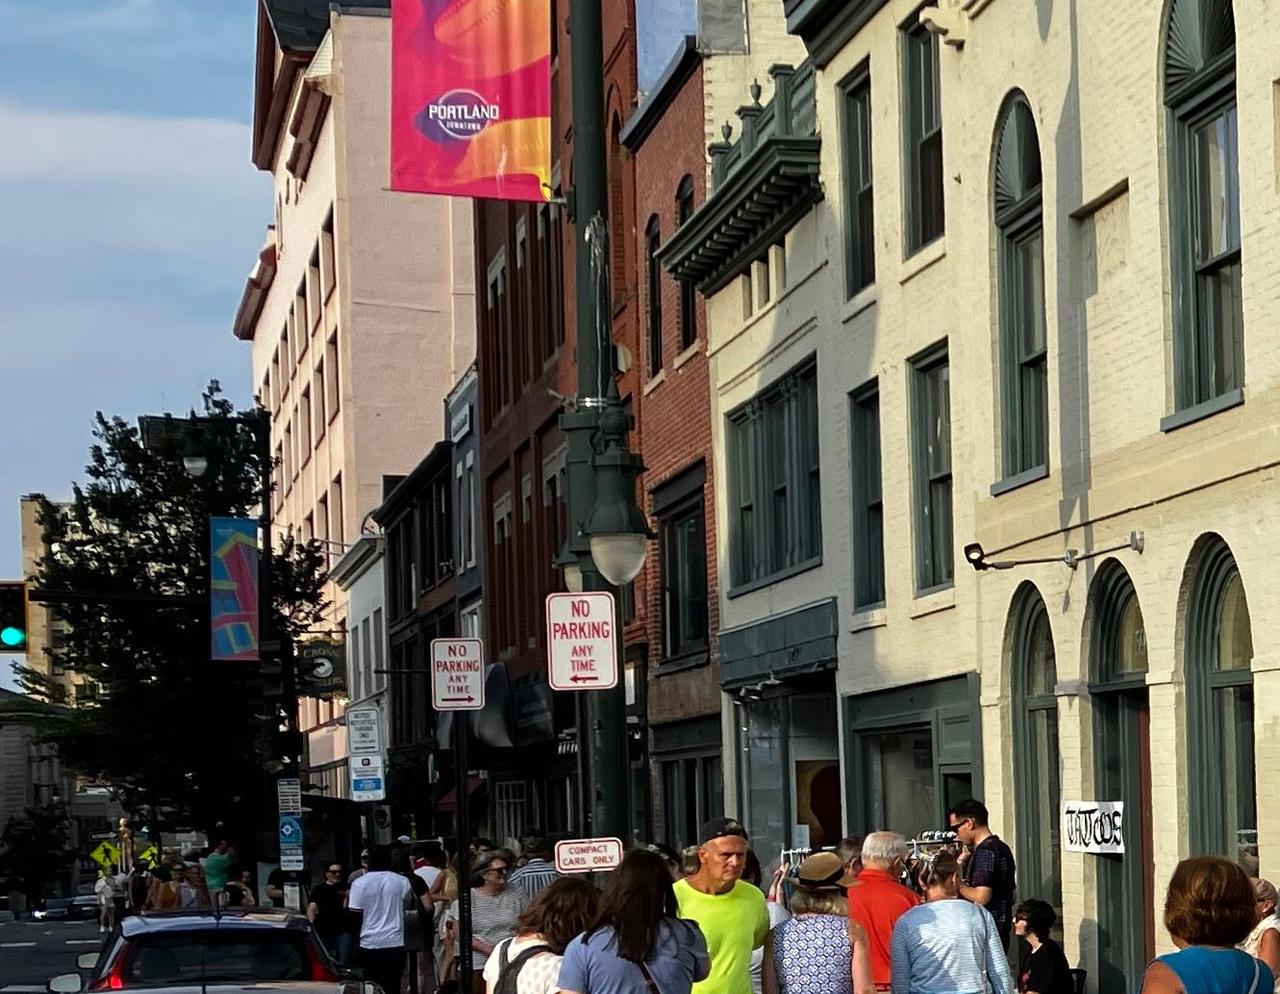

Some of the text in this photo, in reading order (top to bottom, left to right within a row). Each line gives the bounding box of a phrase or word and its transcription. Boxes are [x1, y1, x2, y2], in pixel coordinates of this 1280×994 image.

[428, 104, 500, 120] PORTLAND
[571, 600, 590, 618] NO
[553, 621, 610, 640] PARKING
[448, 645, 467, 657] NO
[571, 645, 593, 657] ANY
[436, 660, 480, 672] PARKING
[570, 660, 595, 672] TIME
[448, 675, 468, 683] ANY
[447, 685, 471, 694] TIME
[1065, 807, 1122, 847] TATTOOS
[569, 845, 608, 854] COMPACT
[562, 855, 614, 866] CARS ONLY
